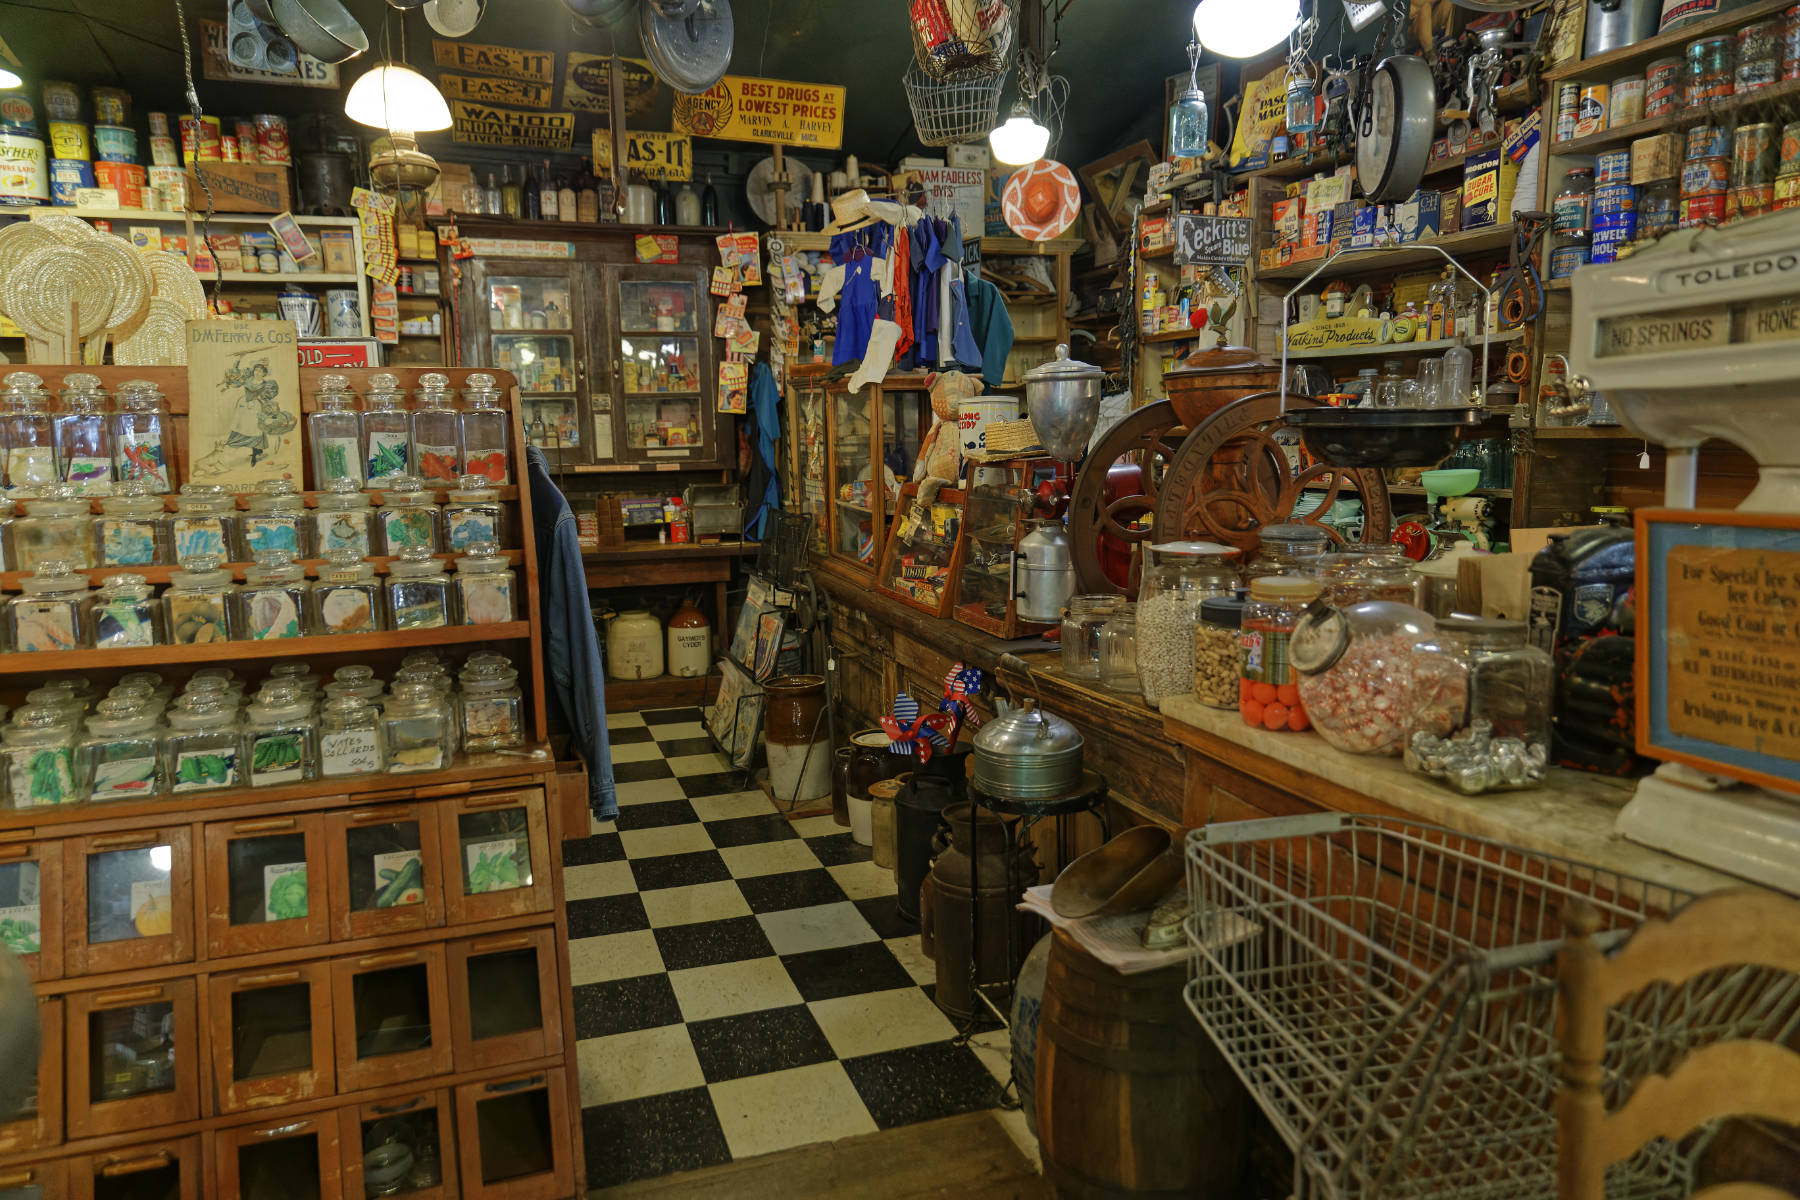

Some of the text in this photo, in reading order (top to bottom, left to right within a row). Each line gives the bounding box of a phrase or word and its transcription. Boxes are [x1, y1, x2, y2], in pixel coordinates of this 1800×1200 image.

[458, 46, 549, 73] EAS-IT
[742, 83, 834, 103] BEST DRUGS AT
[1260, 94, 1287, 109] PASC
[462, 106, 565, 127] WAHOO
[738, 99, 837, 120] LOWEST PRICES
[1258, 105, 1287, 121] MAGI
[739, 114, 772, 126] MARVIN
[519, 125, 570, 140] TONIC
[627, 139, 689, 167] AS-IT
[1465, 159, 1500, 174] MORTON
[941, 171, 982, 185] FADELESS
[1467, 174, 1493, 193] SUGAR
[1474, 183, 1494, 198] CURE
[1178, 217, 1248, 257] Reckitt's
[1593, 228, 1628, 243] AXWELL
[1222, 238, 1250, 256] Blue
[1676, 255, 1798, 286] TOLEDO
[1325, 327, 1376, 345] Products
[1611, 308, 1800, 348] NO SPRINGS HONE
